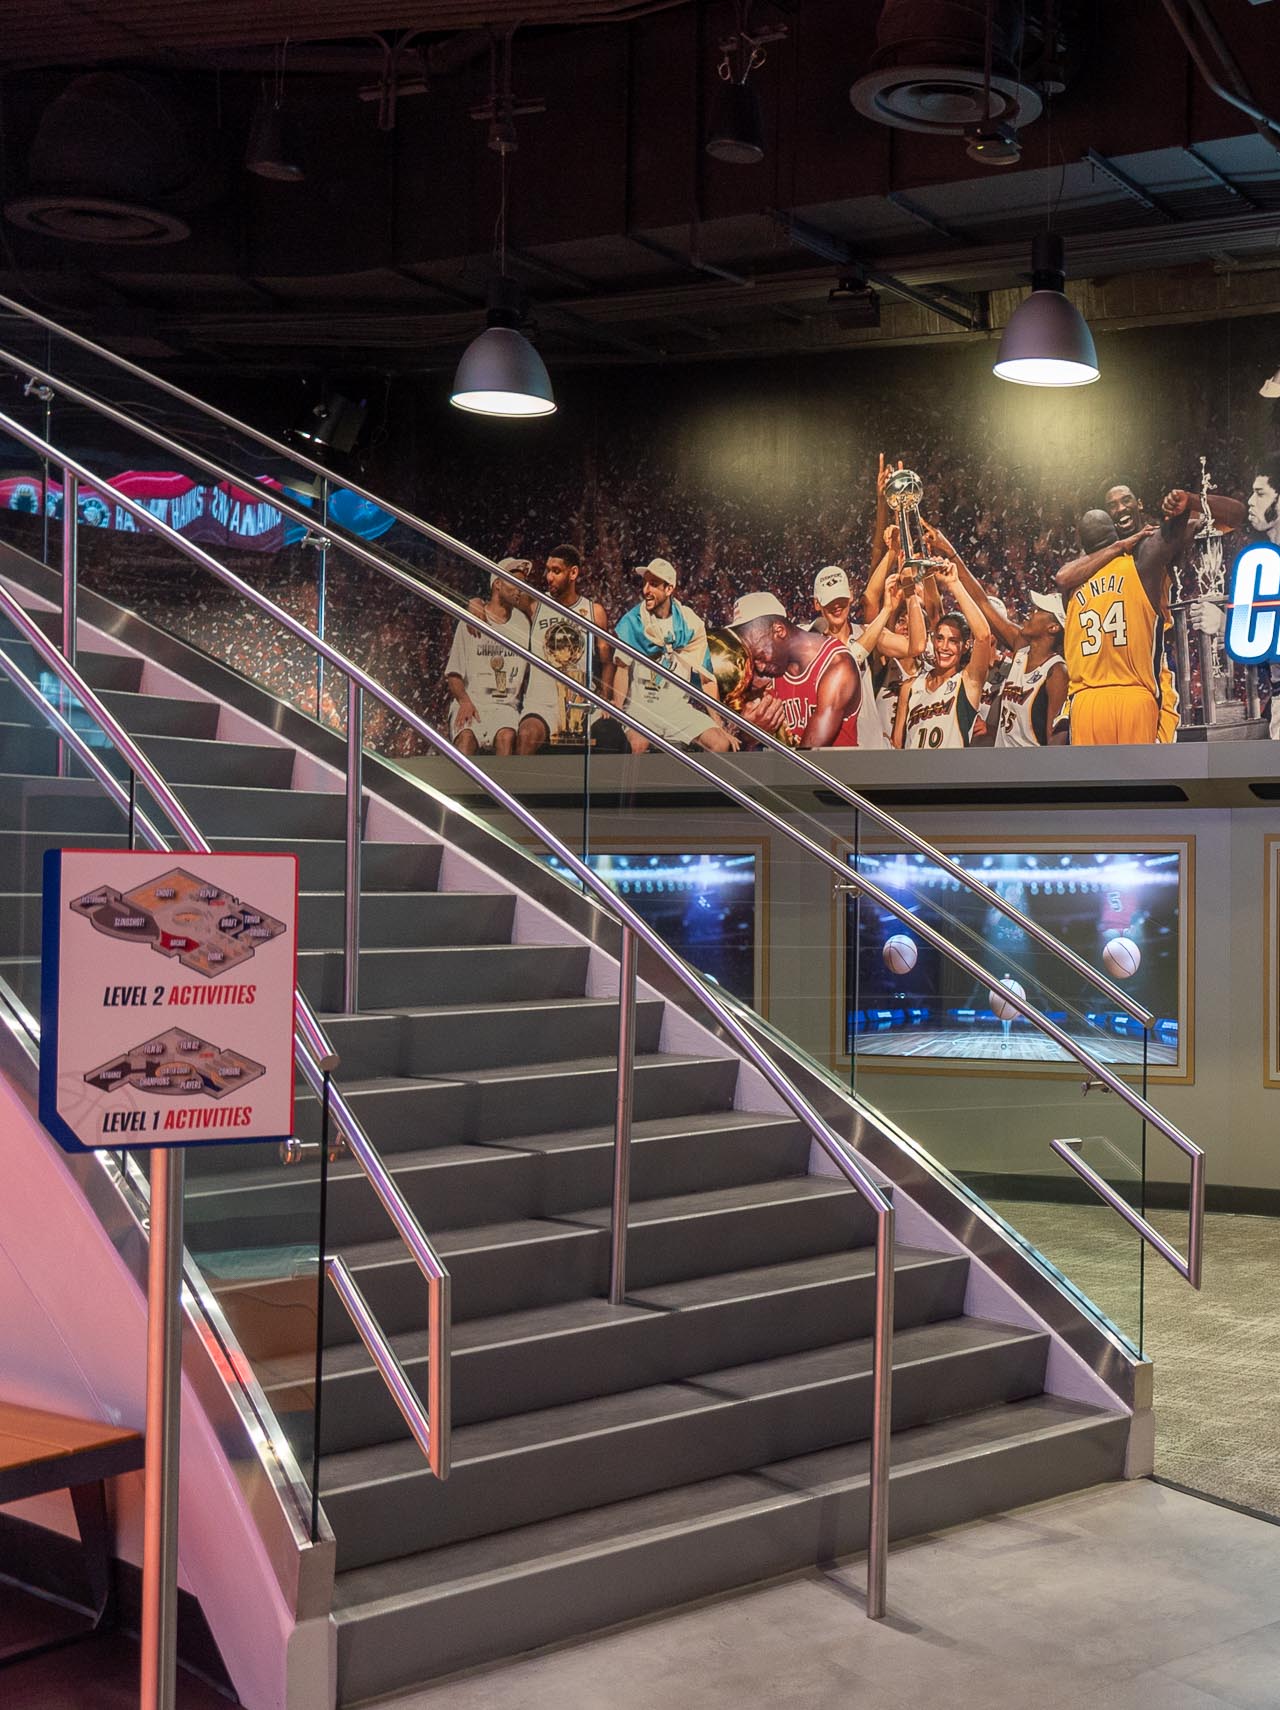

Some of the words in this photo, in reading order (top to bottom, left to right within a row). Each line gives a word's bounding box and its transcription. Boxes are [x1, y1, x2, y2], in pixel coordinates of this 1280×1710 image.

[1078, 600, 1128, 657] 34
[918, 727, 944, 749] 10
[103, 986, 148, 1007] LEVEL
[152, 986, 165, 1006] 2
[168, 984, 257, 1006] ACTIVITIES
[102, 1110, 146, 1133] LEVEL
[152, 1110, 161, 1130] 1
[163, 1106, 253, 1130] ACTIVITIES
